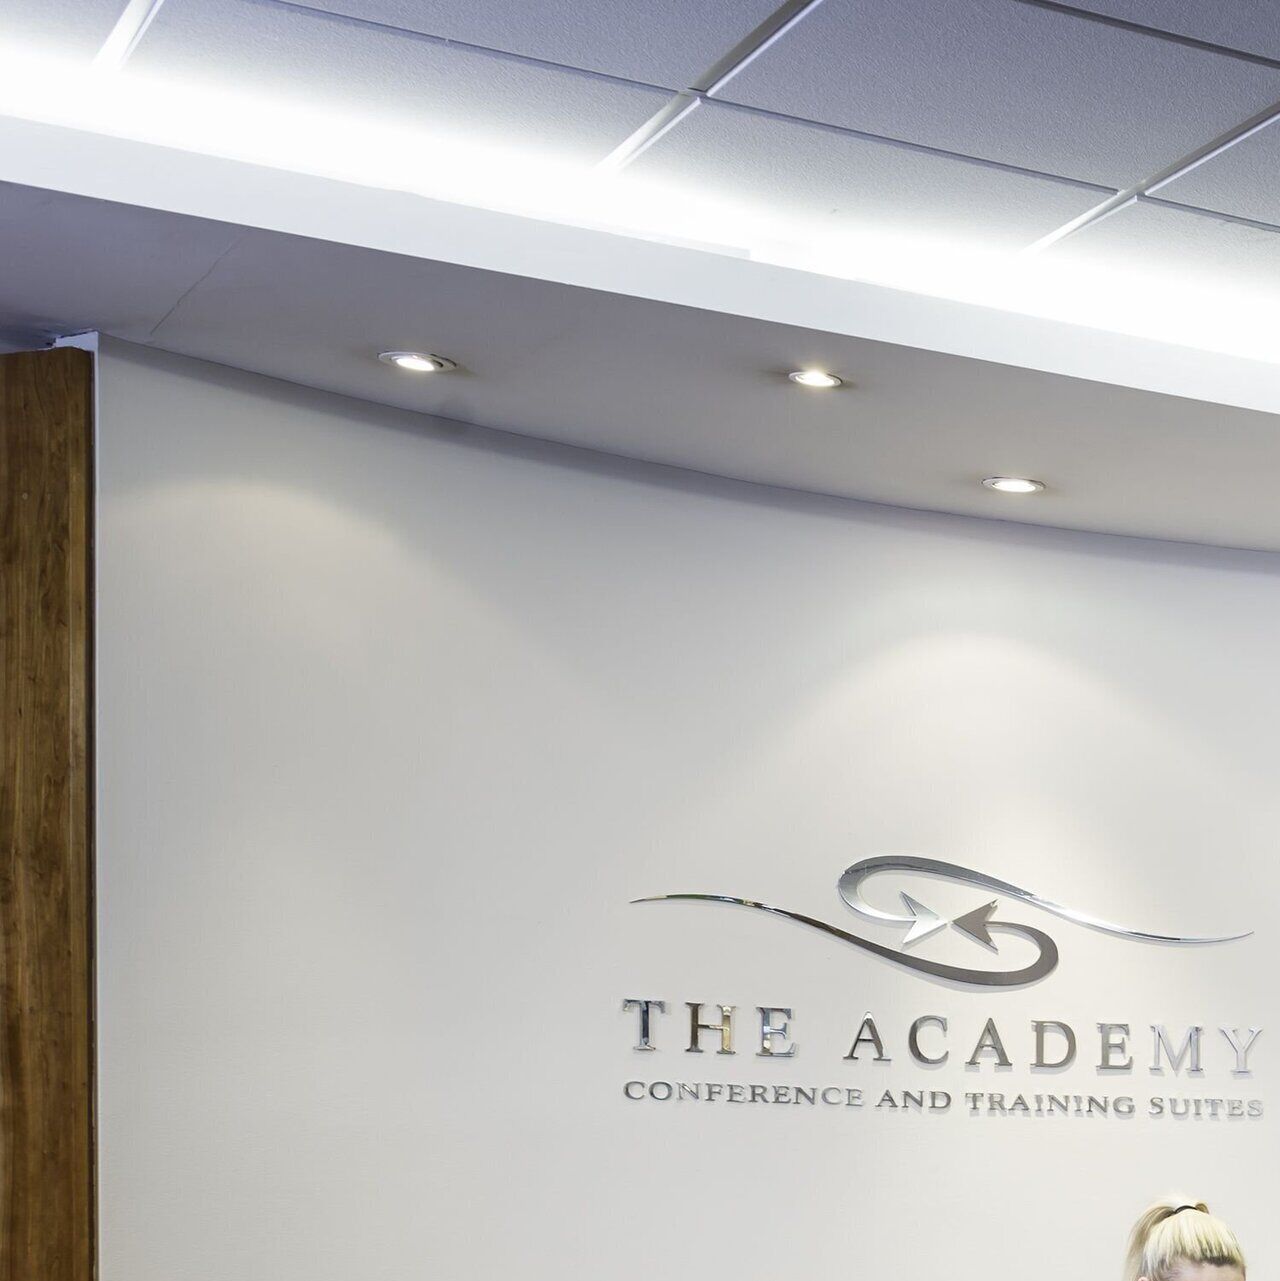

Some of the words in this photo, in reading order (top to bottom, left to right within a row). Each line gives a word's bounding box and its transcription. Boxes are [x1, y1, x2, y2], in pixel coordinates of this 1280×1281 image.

[624, 998, 800, 1059] THE
[842, 1010, 1263, 1075] ACADEMY
[623, 1080, 865, 1107] CONFERENCE
[876, 1089, 952, 1110] AND
[965, 1091, 1136, 1115] TRAINING
[1148, 1096, 1264, 1118] SUITES
